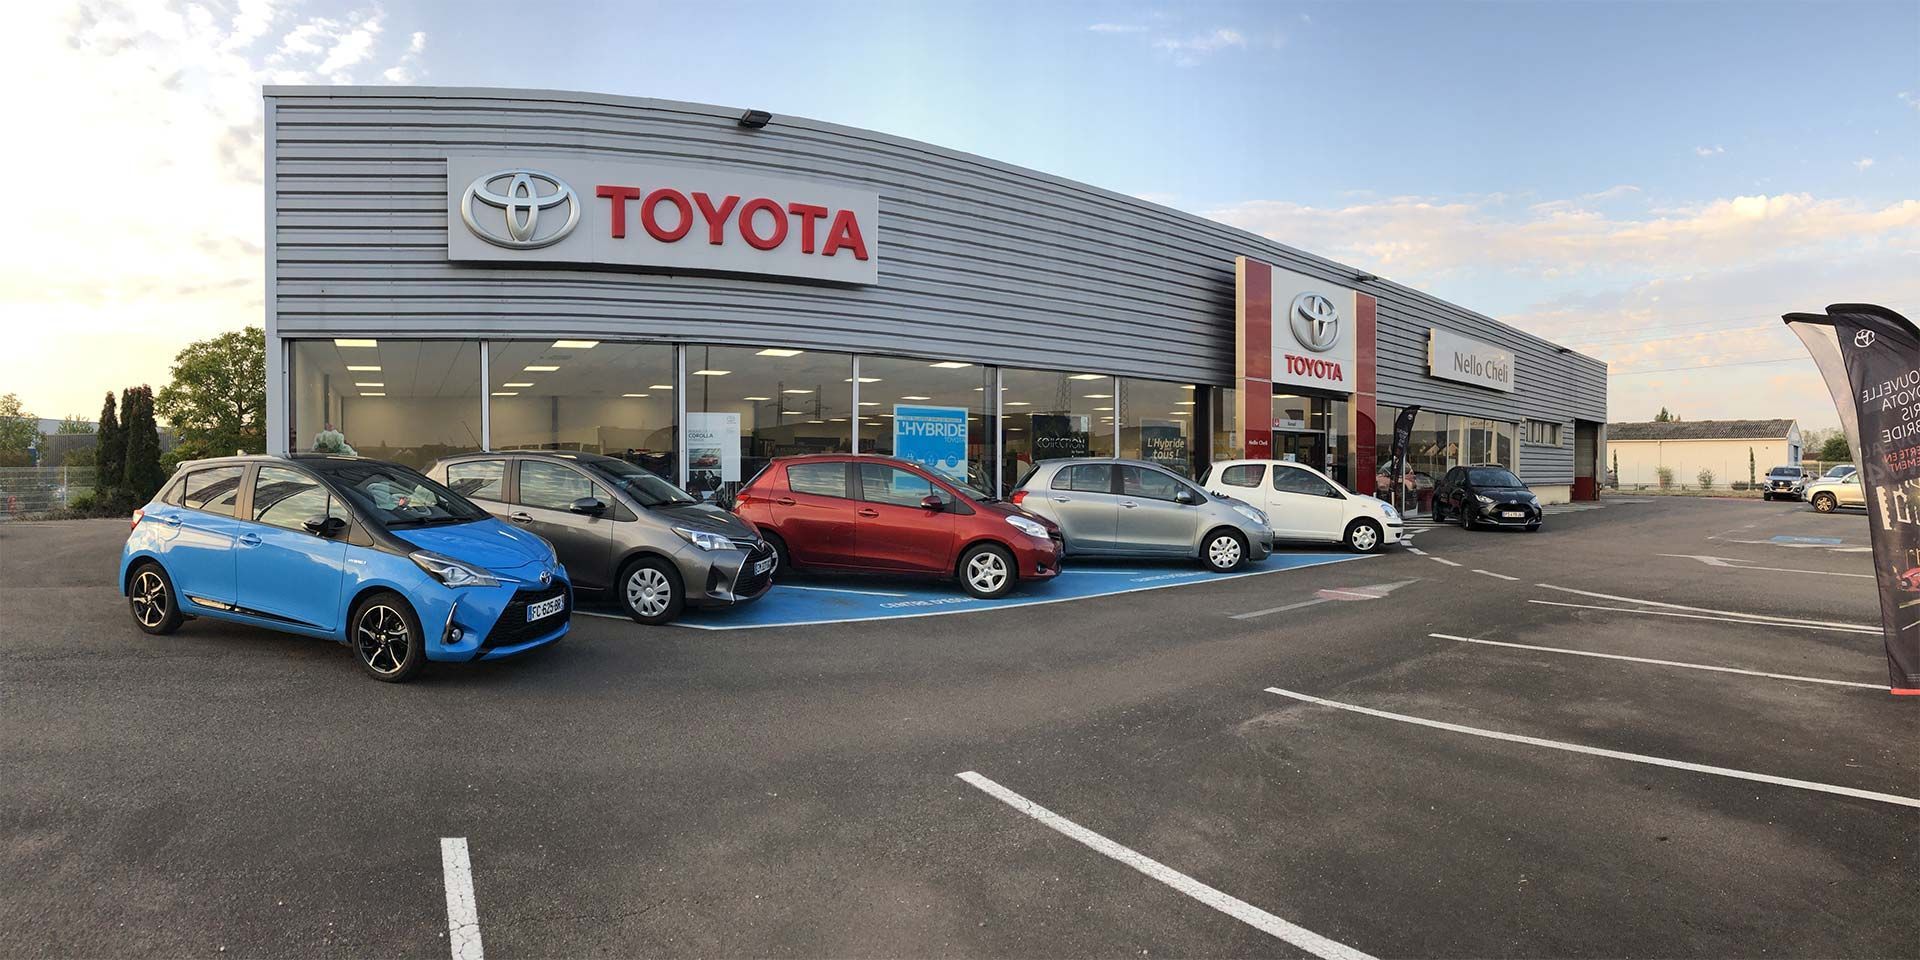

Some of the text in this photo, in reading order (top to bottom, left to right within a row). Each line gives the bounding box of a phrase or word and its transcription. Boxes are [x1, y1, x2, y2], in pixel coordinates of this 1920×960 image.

[596, 185, 869, 260] TOYOTA
[1284, 354, 1343, 381] TOYOTA
[1454, 351, 1508, 383] Nello Cheli
[896, 420, 966, 437] L'HYBRIDE
[1147, 437, 1185, 450] L'Hybride
